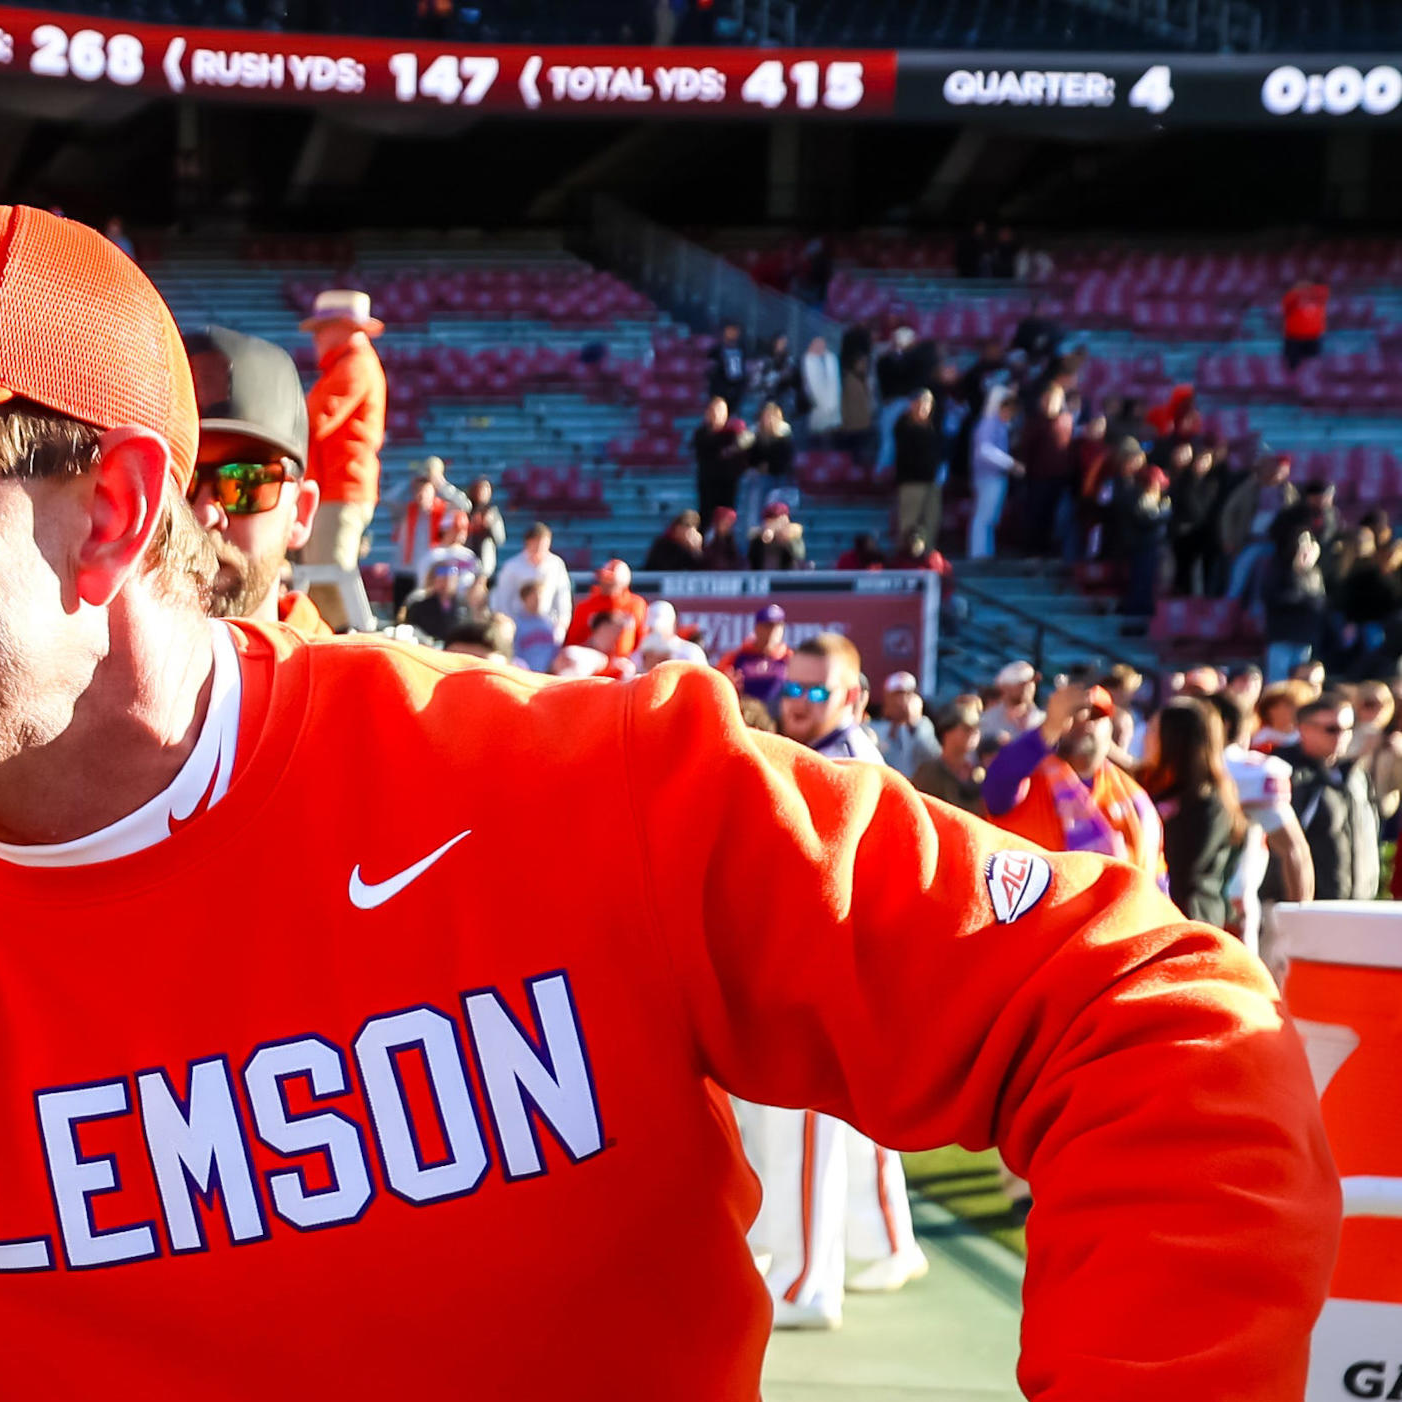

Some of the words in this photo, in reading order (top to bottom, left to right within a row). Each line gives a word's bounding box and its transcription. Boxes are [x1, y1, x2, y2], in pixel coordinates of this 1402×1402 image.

[30, 25, 144, 86] 268
[191, 48, 284, 88] RUSH
[290, 55, 366, 93] YDS:
[389, 52, 499, 104] 147
[549, 65, 653, 100] TOTAL
[654, 66, 726, 101] YDS:
[741, 60, 864, 109] 415
[942, 69, 1115, 106] QUARTER:
[1128, 64, 1174, 113] 4
[1260, 64, 1402, 115] 0:00
